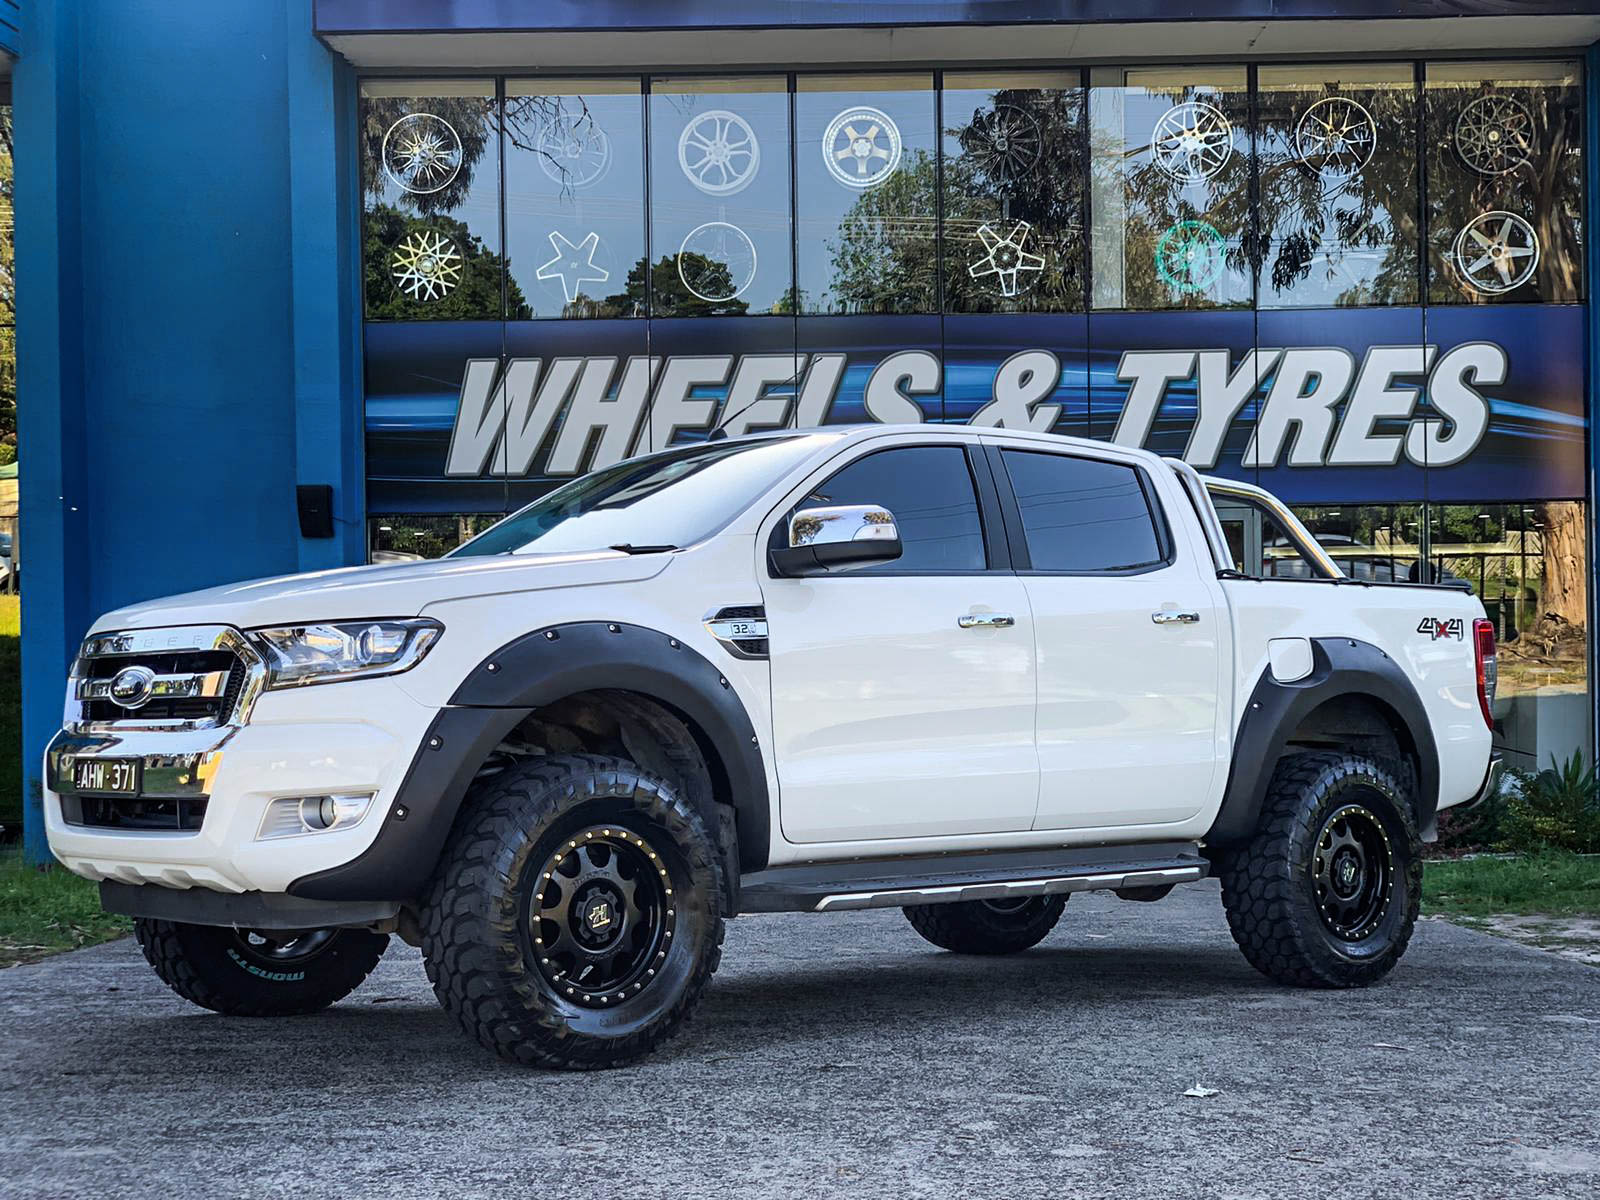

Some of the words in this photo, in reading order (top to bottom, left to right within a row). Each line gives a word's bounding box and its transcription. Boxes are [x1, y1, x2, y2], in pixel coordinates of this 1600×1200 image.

[444, 353, 942, 476] WHEELS
[968, 348, 1063, 432] &
[1110, 342, 1508, 468] TYRES
